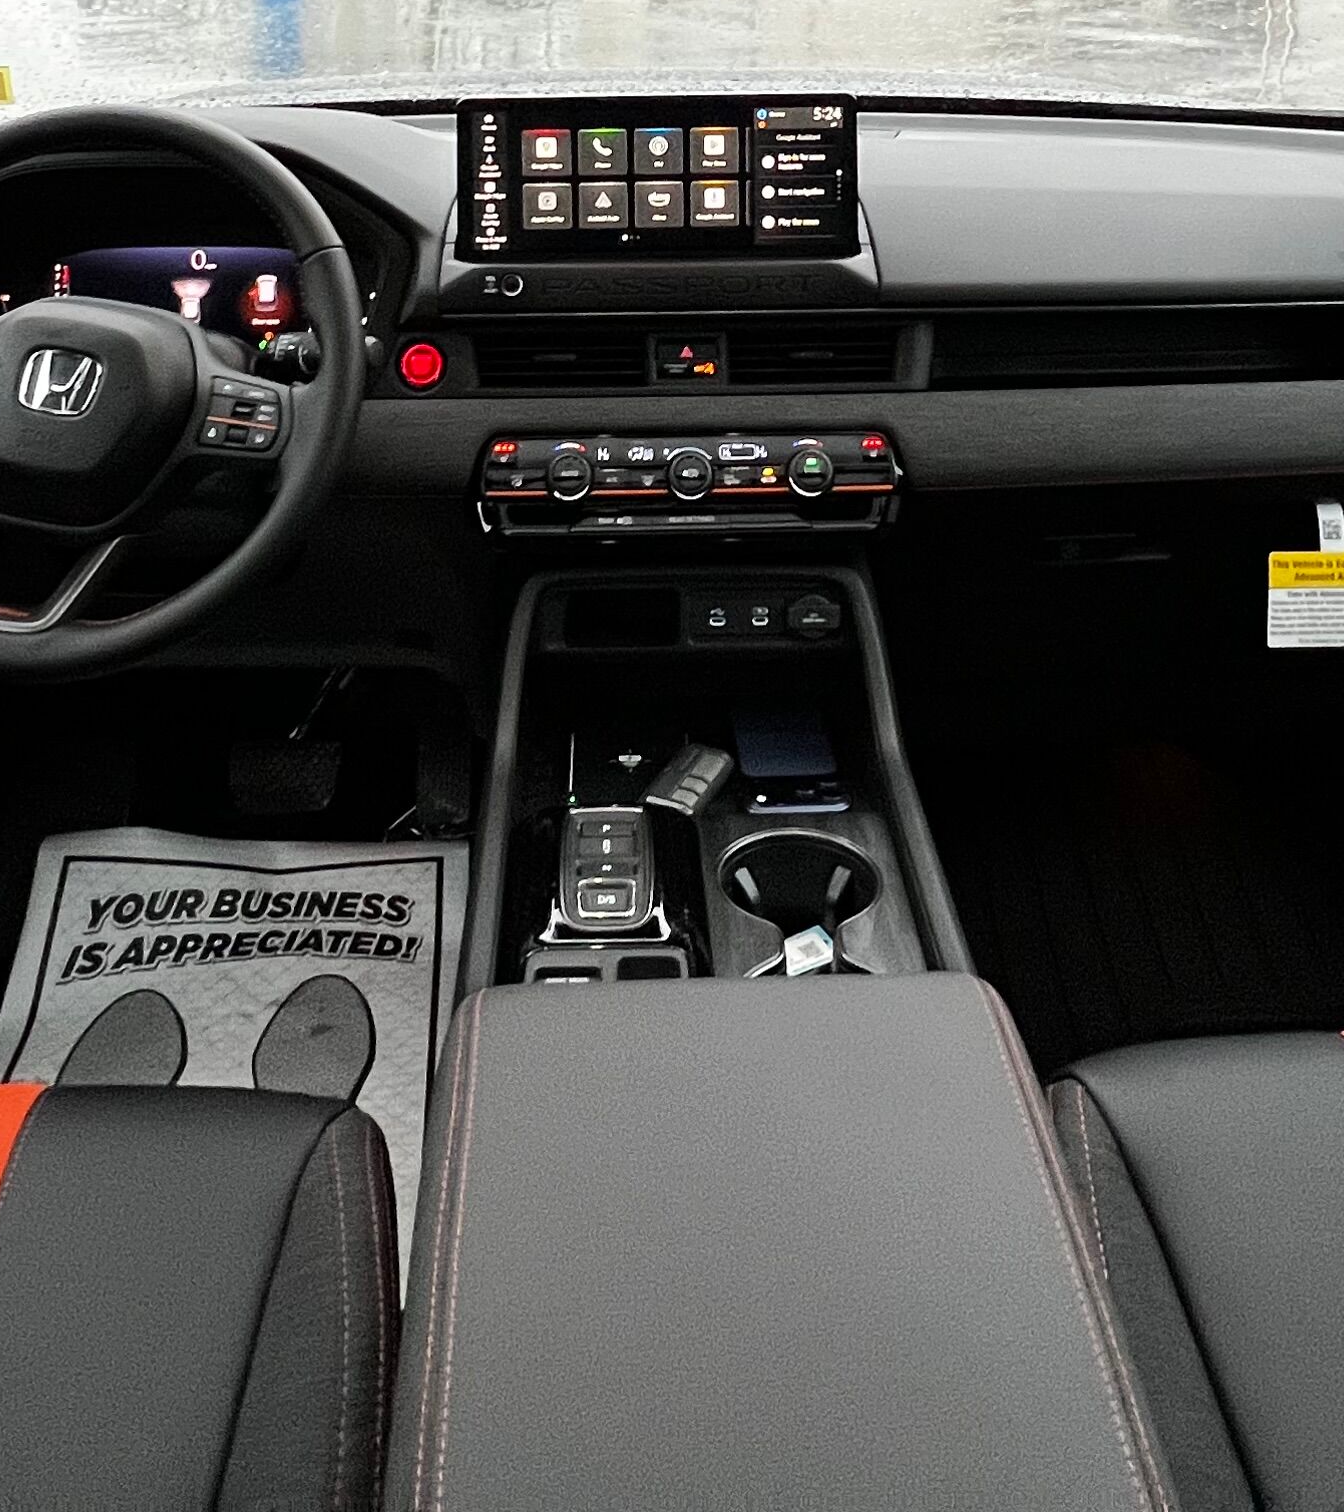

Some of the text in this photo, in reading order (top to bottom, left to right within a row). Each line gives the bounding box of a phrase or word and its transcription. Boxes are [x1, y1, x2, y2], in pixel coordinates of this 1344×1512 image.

[813, 106, 843, 121] 5:24
[85, 888, 414, 933] YOUR BUSINESS
[59, 929, 422, 983] IS APPRECIATED!
